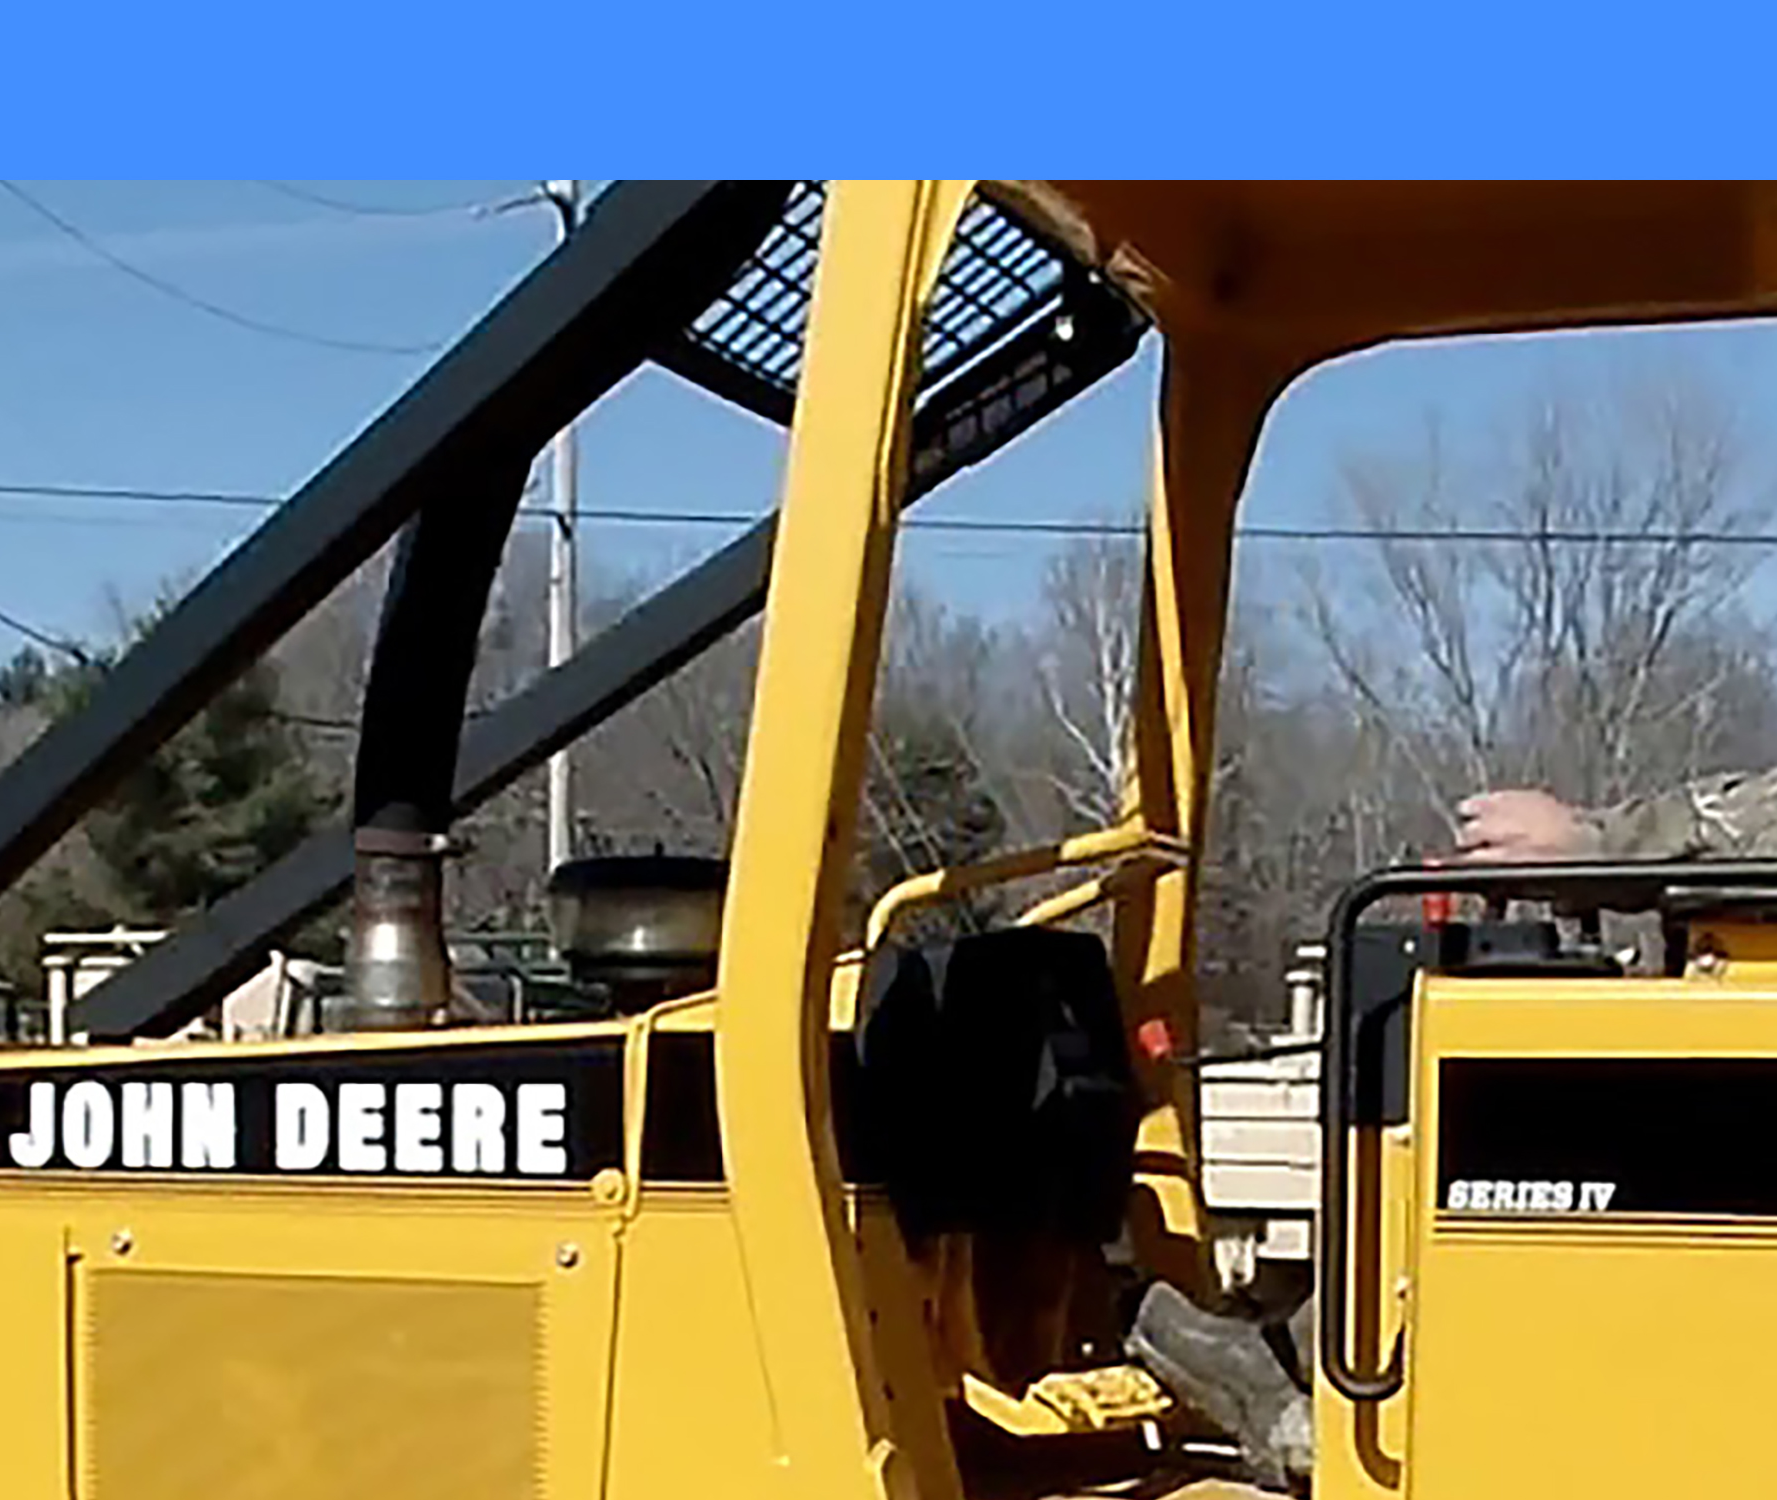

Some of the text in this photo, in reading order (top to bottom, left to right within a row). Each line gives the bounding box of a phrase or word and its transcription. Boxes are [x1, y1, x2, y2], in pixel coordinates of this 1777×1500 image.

[8, 1080, 567, 1174] JOHN DEERE
[1447, 1179, 1616, 1211] SERIES IV
